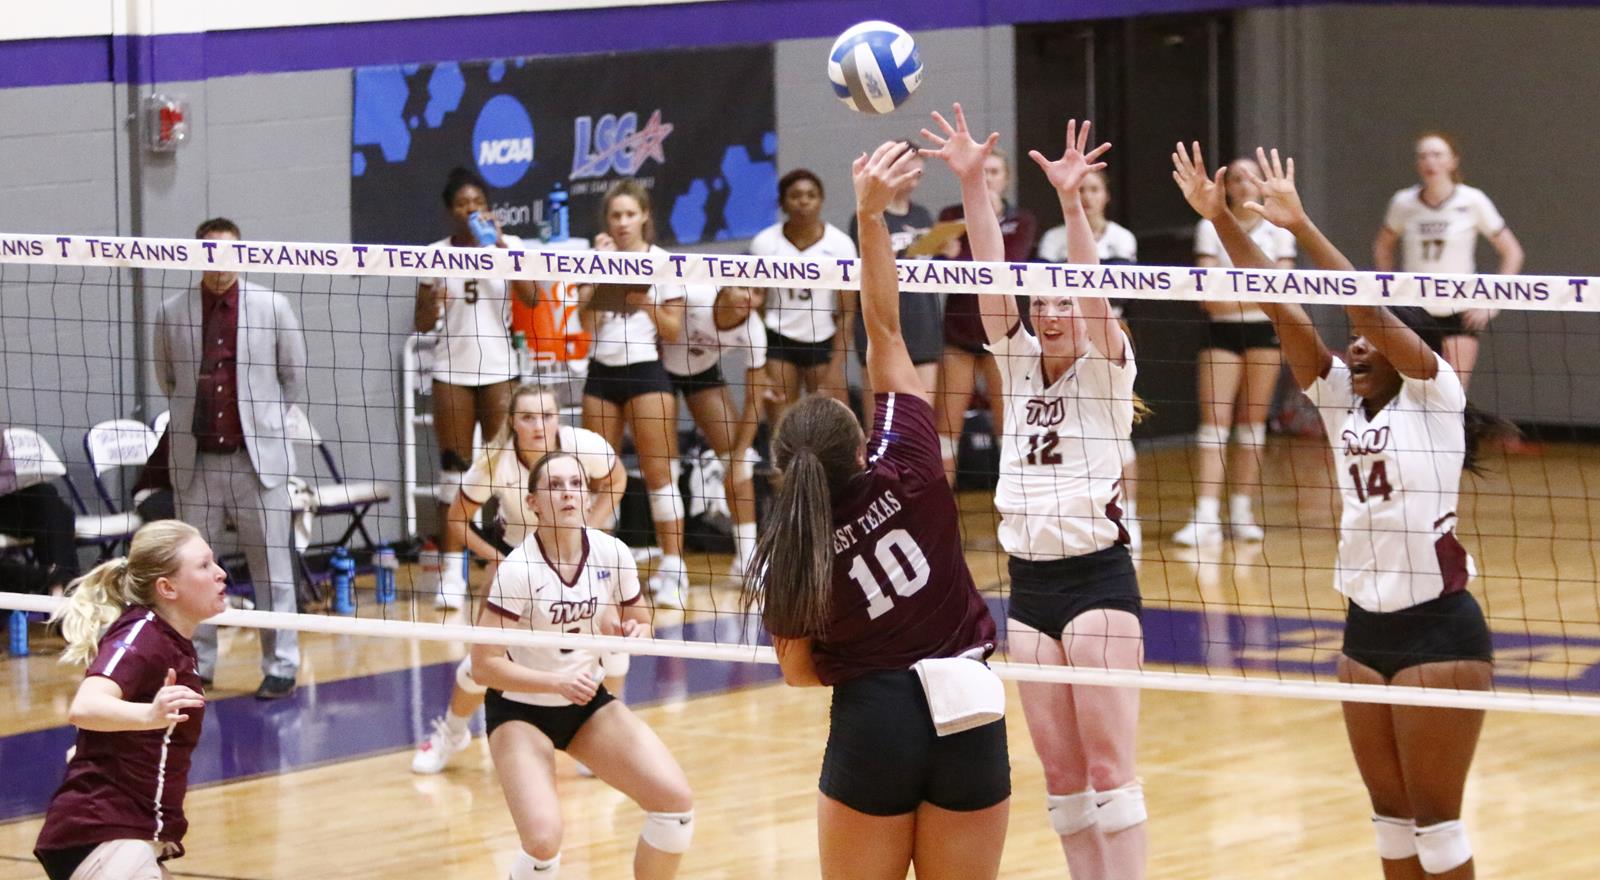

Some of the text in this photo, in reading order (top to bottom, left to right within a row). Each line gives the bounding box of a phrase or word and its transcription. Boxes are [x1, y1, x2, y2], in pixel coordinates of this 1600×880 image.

[479, 137, 534, 166] NCAA
[570, 111, 639, 179] LSC
[491, 202, 531, 226] ision
[0, 239, 44, 256] NNS
[56, 237, 71, 258] T
[201, 242, 218, 264] T
[352, 246, 369, 268] T
[508, 251, 524, 272] T
[669, 255, 686, 277] T
[837, 259, 854, 282] T
[896, 262, 993, 285] XANNS
[1009, 264, 1028, 287] T
[1189, 269, 1207, 292] T
[1375, 274, 1394, 297] T
[1569, 279, 1588, 303] T
[463, 280, 478, 304] 5
[1026, 430, 1062, 465] 12
[1349, 460, 1393, 503] 14
[833, 490, 902, 554] EST TEXAS
[848, 529, 931, 620] 10
